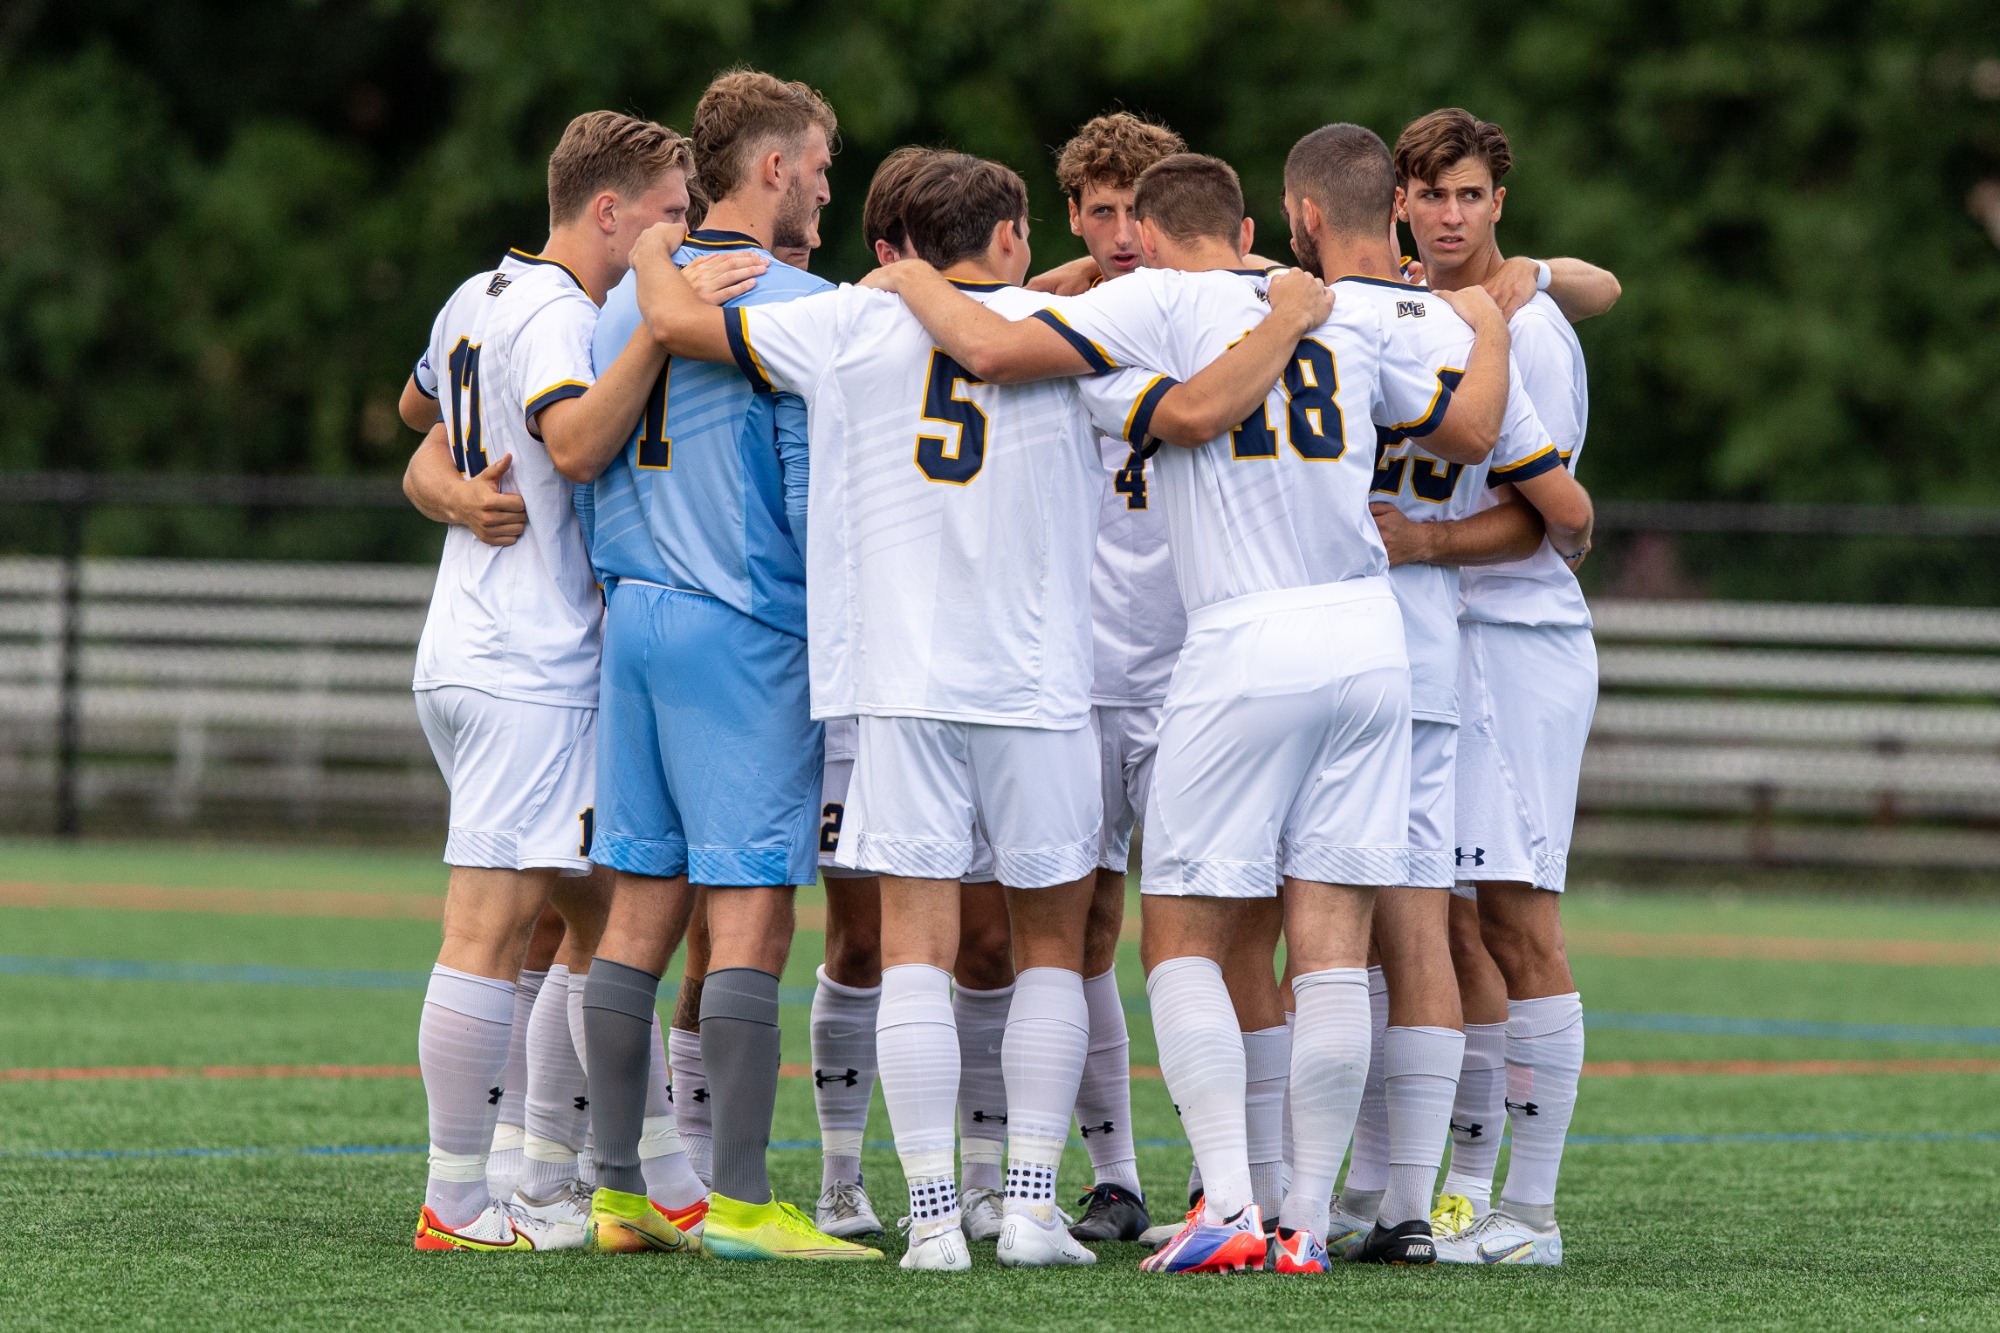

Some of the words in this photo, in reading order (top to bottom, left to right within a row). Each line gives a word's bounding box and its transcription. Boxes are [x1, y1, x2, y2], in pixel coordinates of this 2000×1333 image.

[1396, 301, 1426, 318] MC
[636, 353, 672, 471] 1
[912, 346, 989, 487] 5
[1226, 328, 1348, 462] 18
[1113, 450, 1149, 511] 4
[1405, 1244, 1432, 1257] NIKE
